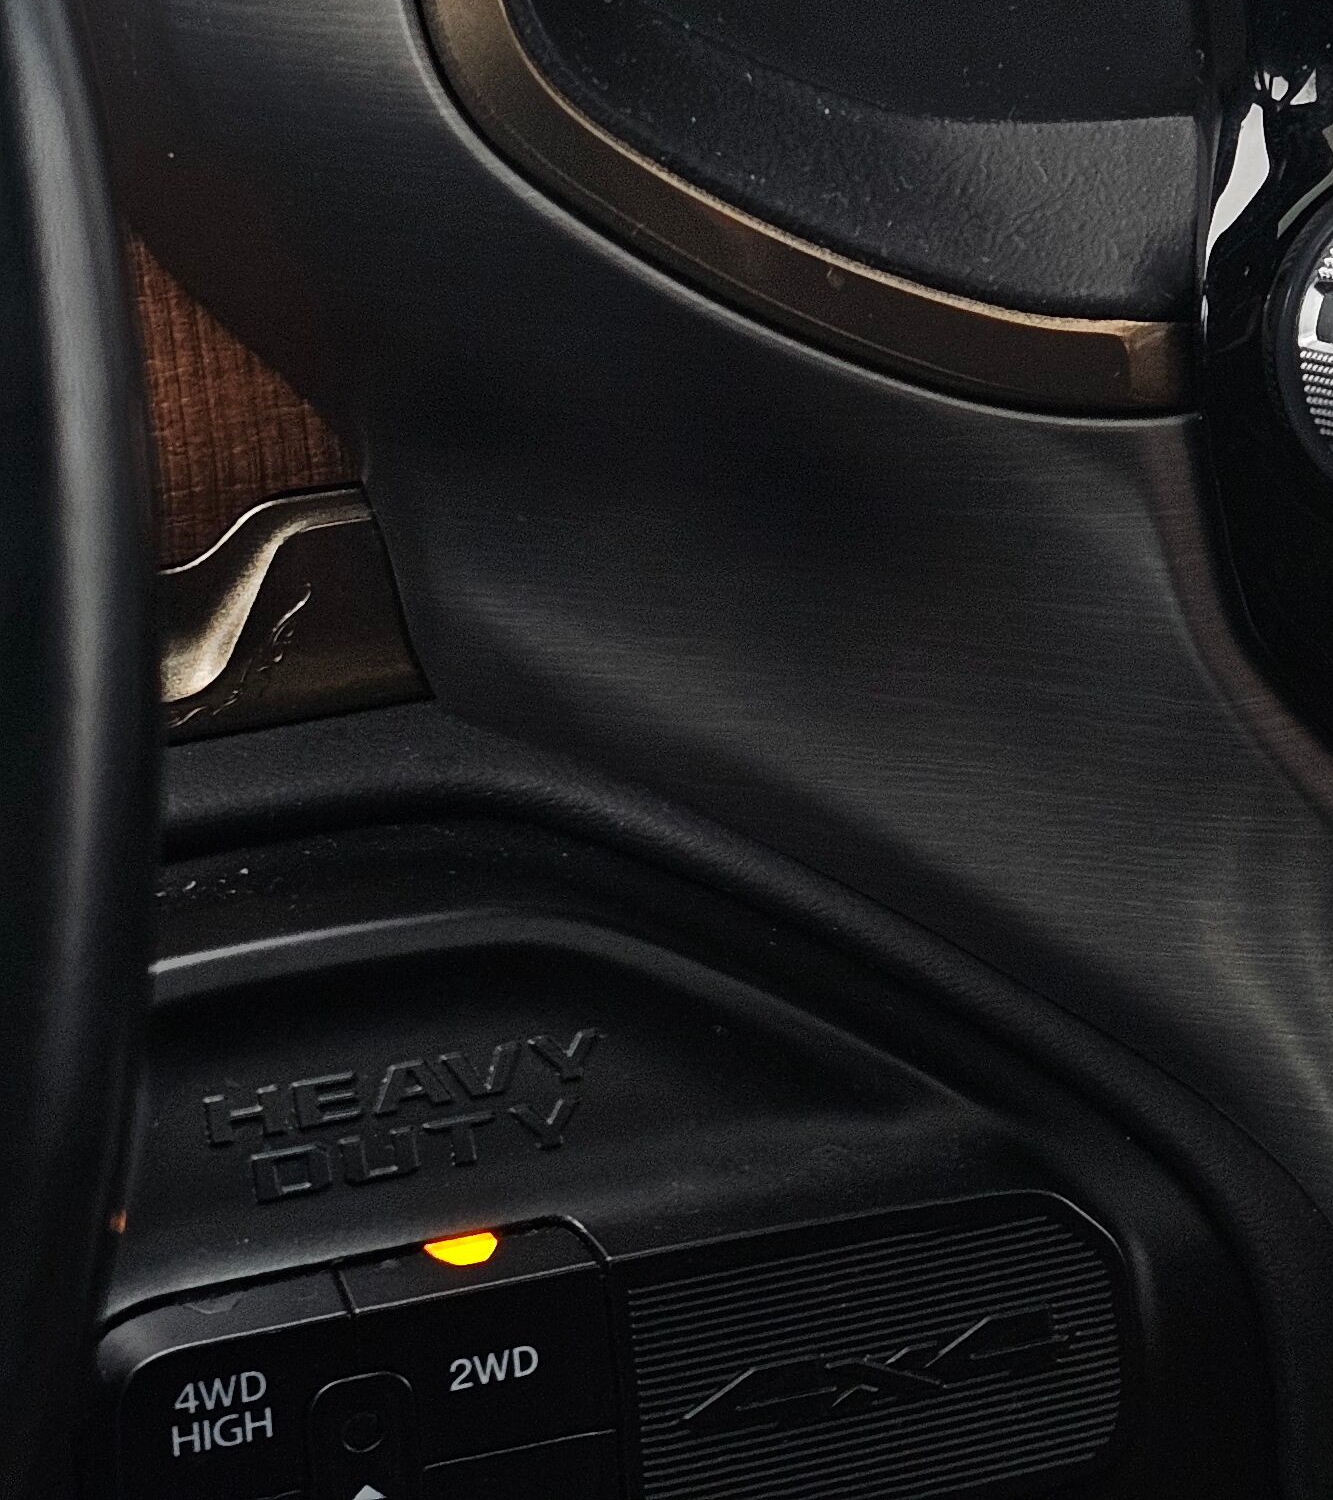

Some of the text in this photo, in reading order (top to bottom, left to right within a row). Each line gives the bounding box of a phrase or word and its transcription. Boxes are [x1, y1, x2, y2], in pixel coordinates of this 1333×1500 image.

[202, 1027, 600, 1146] HEAVY
[250, 1096, 580, 1204] DUTY
[174, 1370, 267, 1414] 4WD
[449, 1345, 539, 1392] 2WD
[171, 1406, 274, 1457] HIGH
